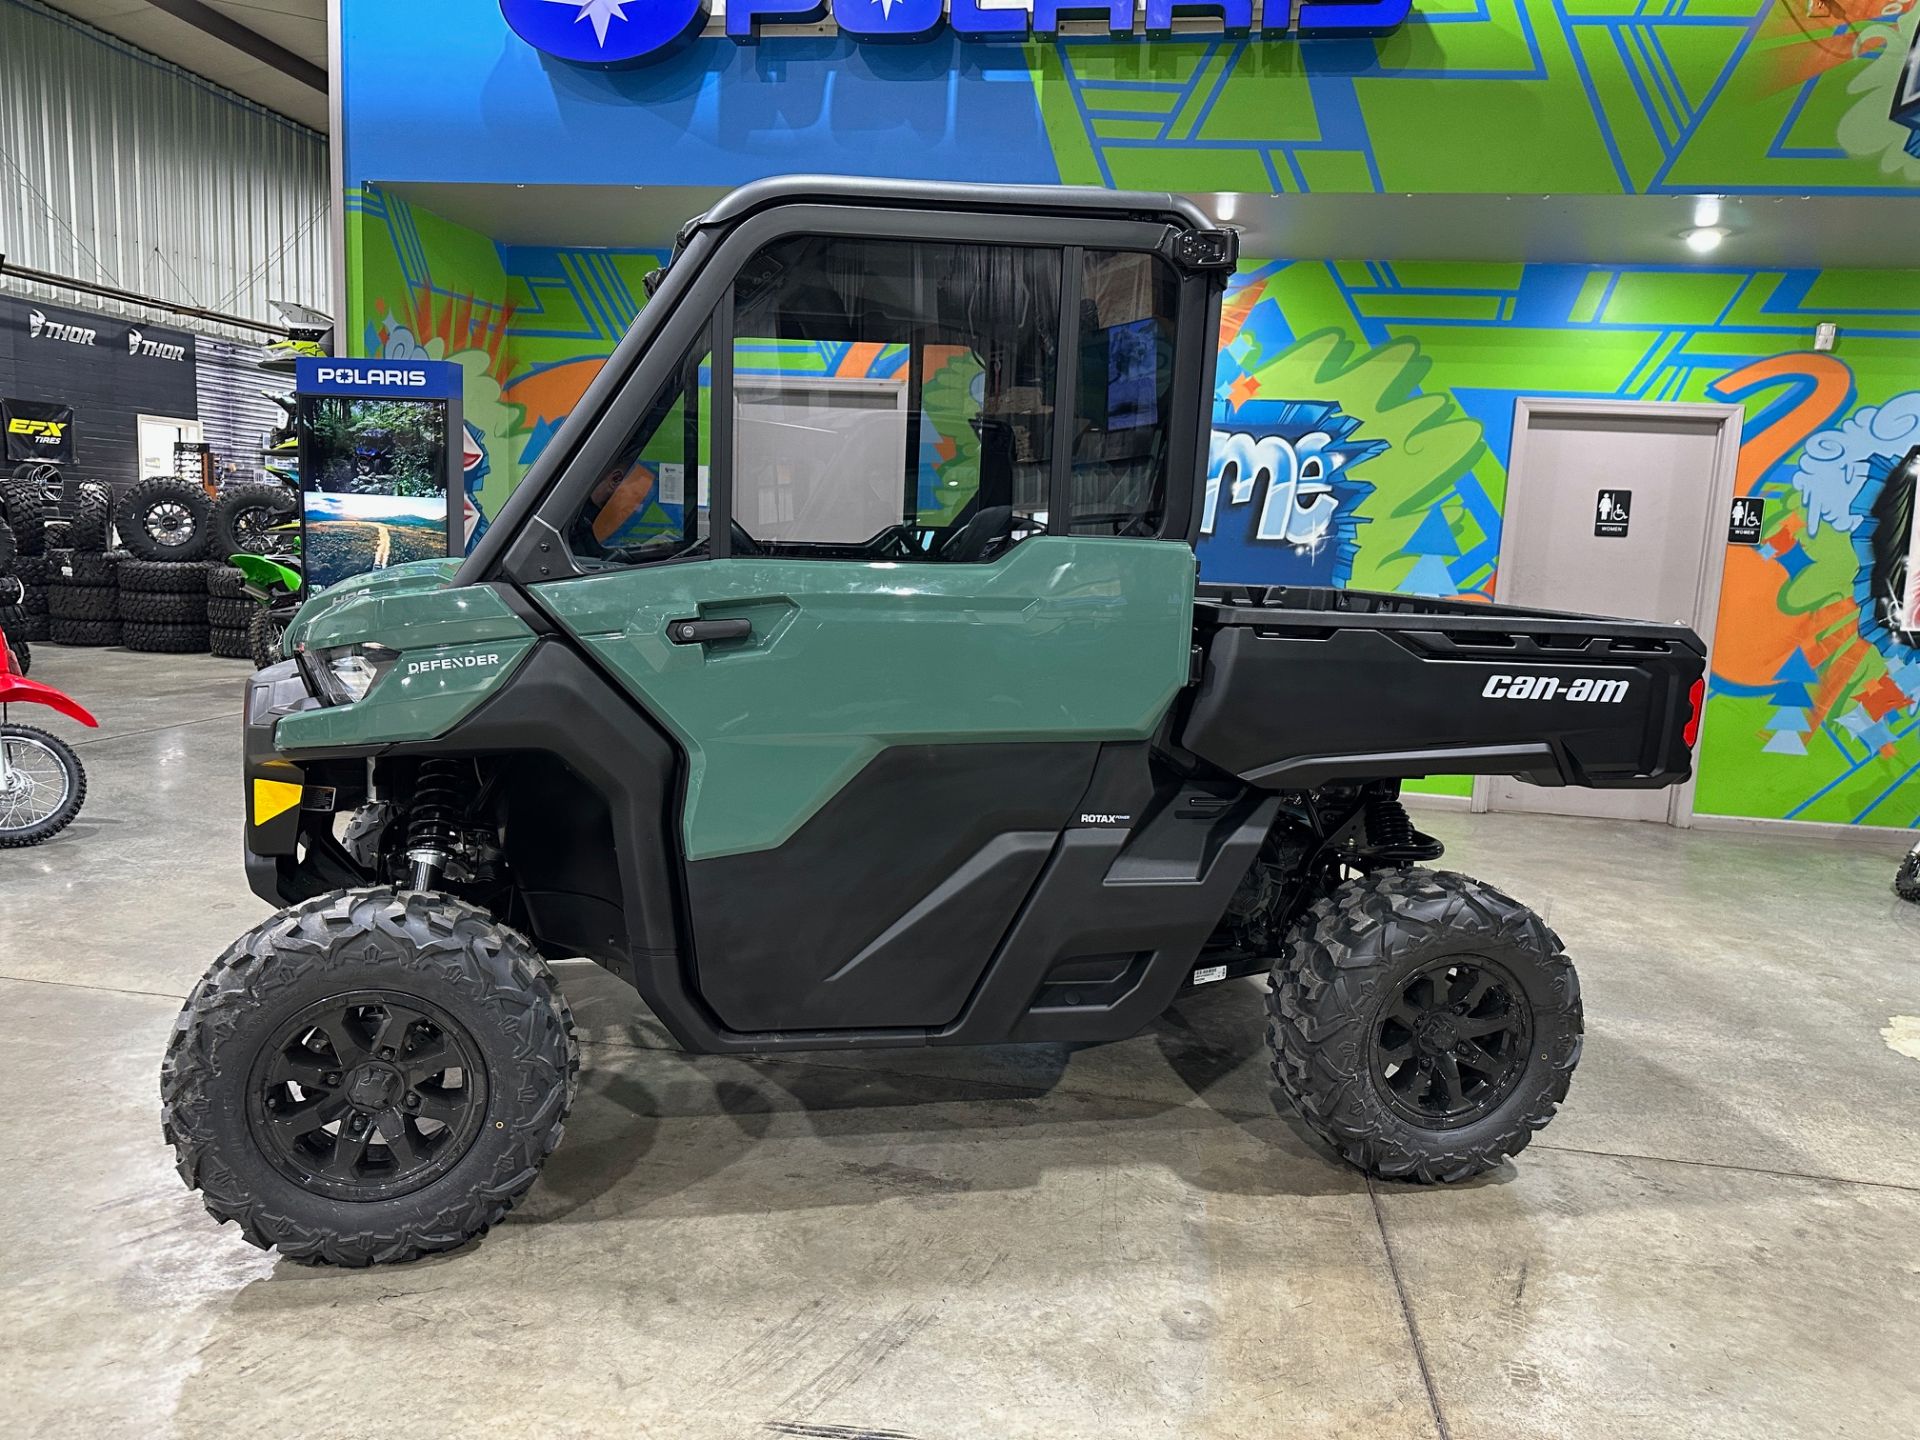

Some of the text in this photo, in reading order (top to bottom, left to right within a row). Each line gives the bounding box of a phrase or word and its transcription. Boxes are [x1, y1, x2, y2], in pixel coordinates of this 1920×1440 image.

[44, 321, 97, 346] THOR
[141, 339, 186, 362] THOR
[317, 367, 427, 387] POLARIS
[8, 418, 68, 437] EFX
[35, 435, 62, 445] TIRES
[408, 653, 499, 675] DEFENDER
[1481, 674, 1630, 703] can-am
[1081, 814, 1116, 823] ROTAX
